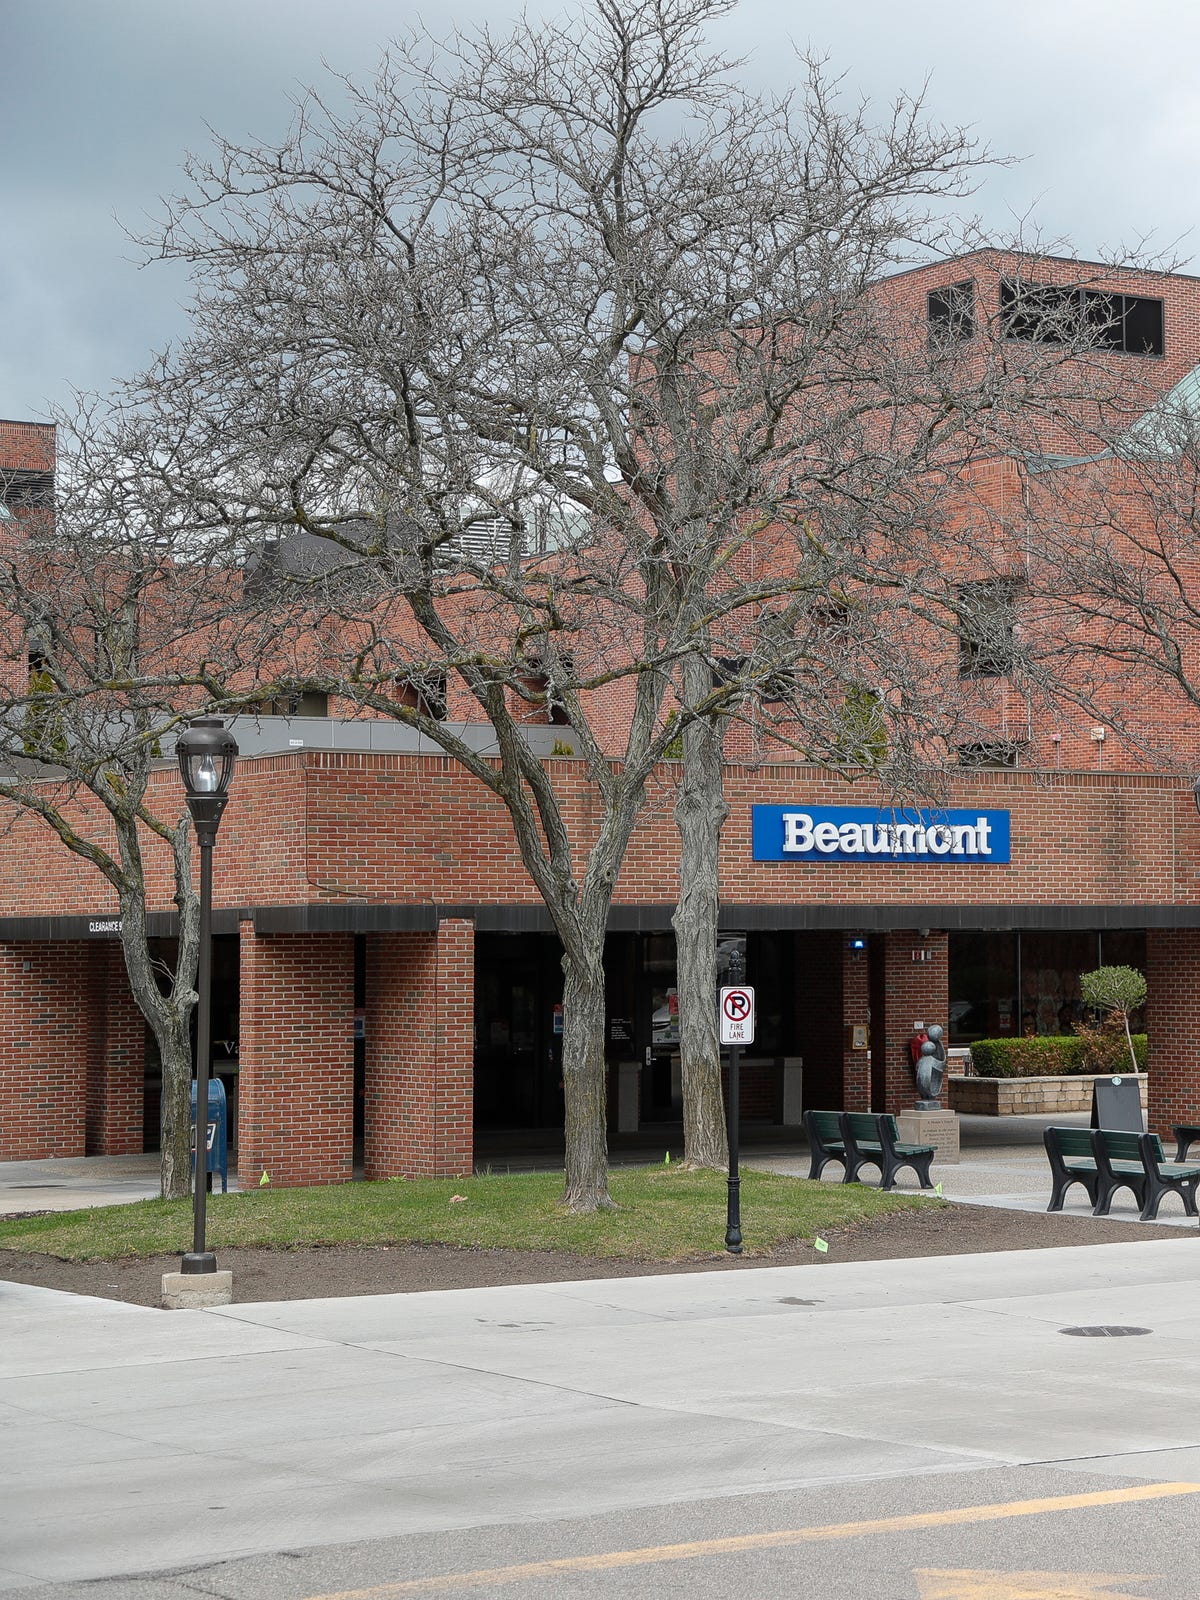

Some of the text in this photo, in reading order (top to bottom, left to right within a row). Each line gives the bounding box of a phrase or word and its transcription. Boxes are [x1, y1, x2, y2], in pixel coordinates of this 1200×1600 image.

[783, 813, 992, 855] Beaumont
[730, 1023, 744, 1031] FIRE
[729, 1031, 745, 1039] LANE
